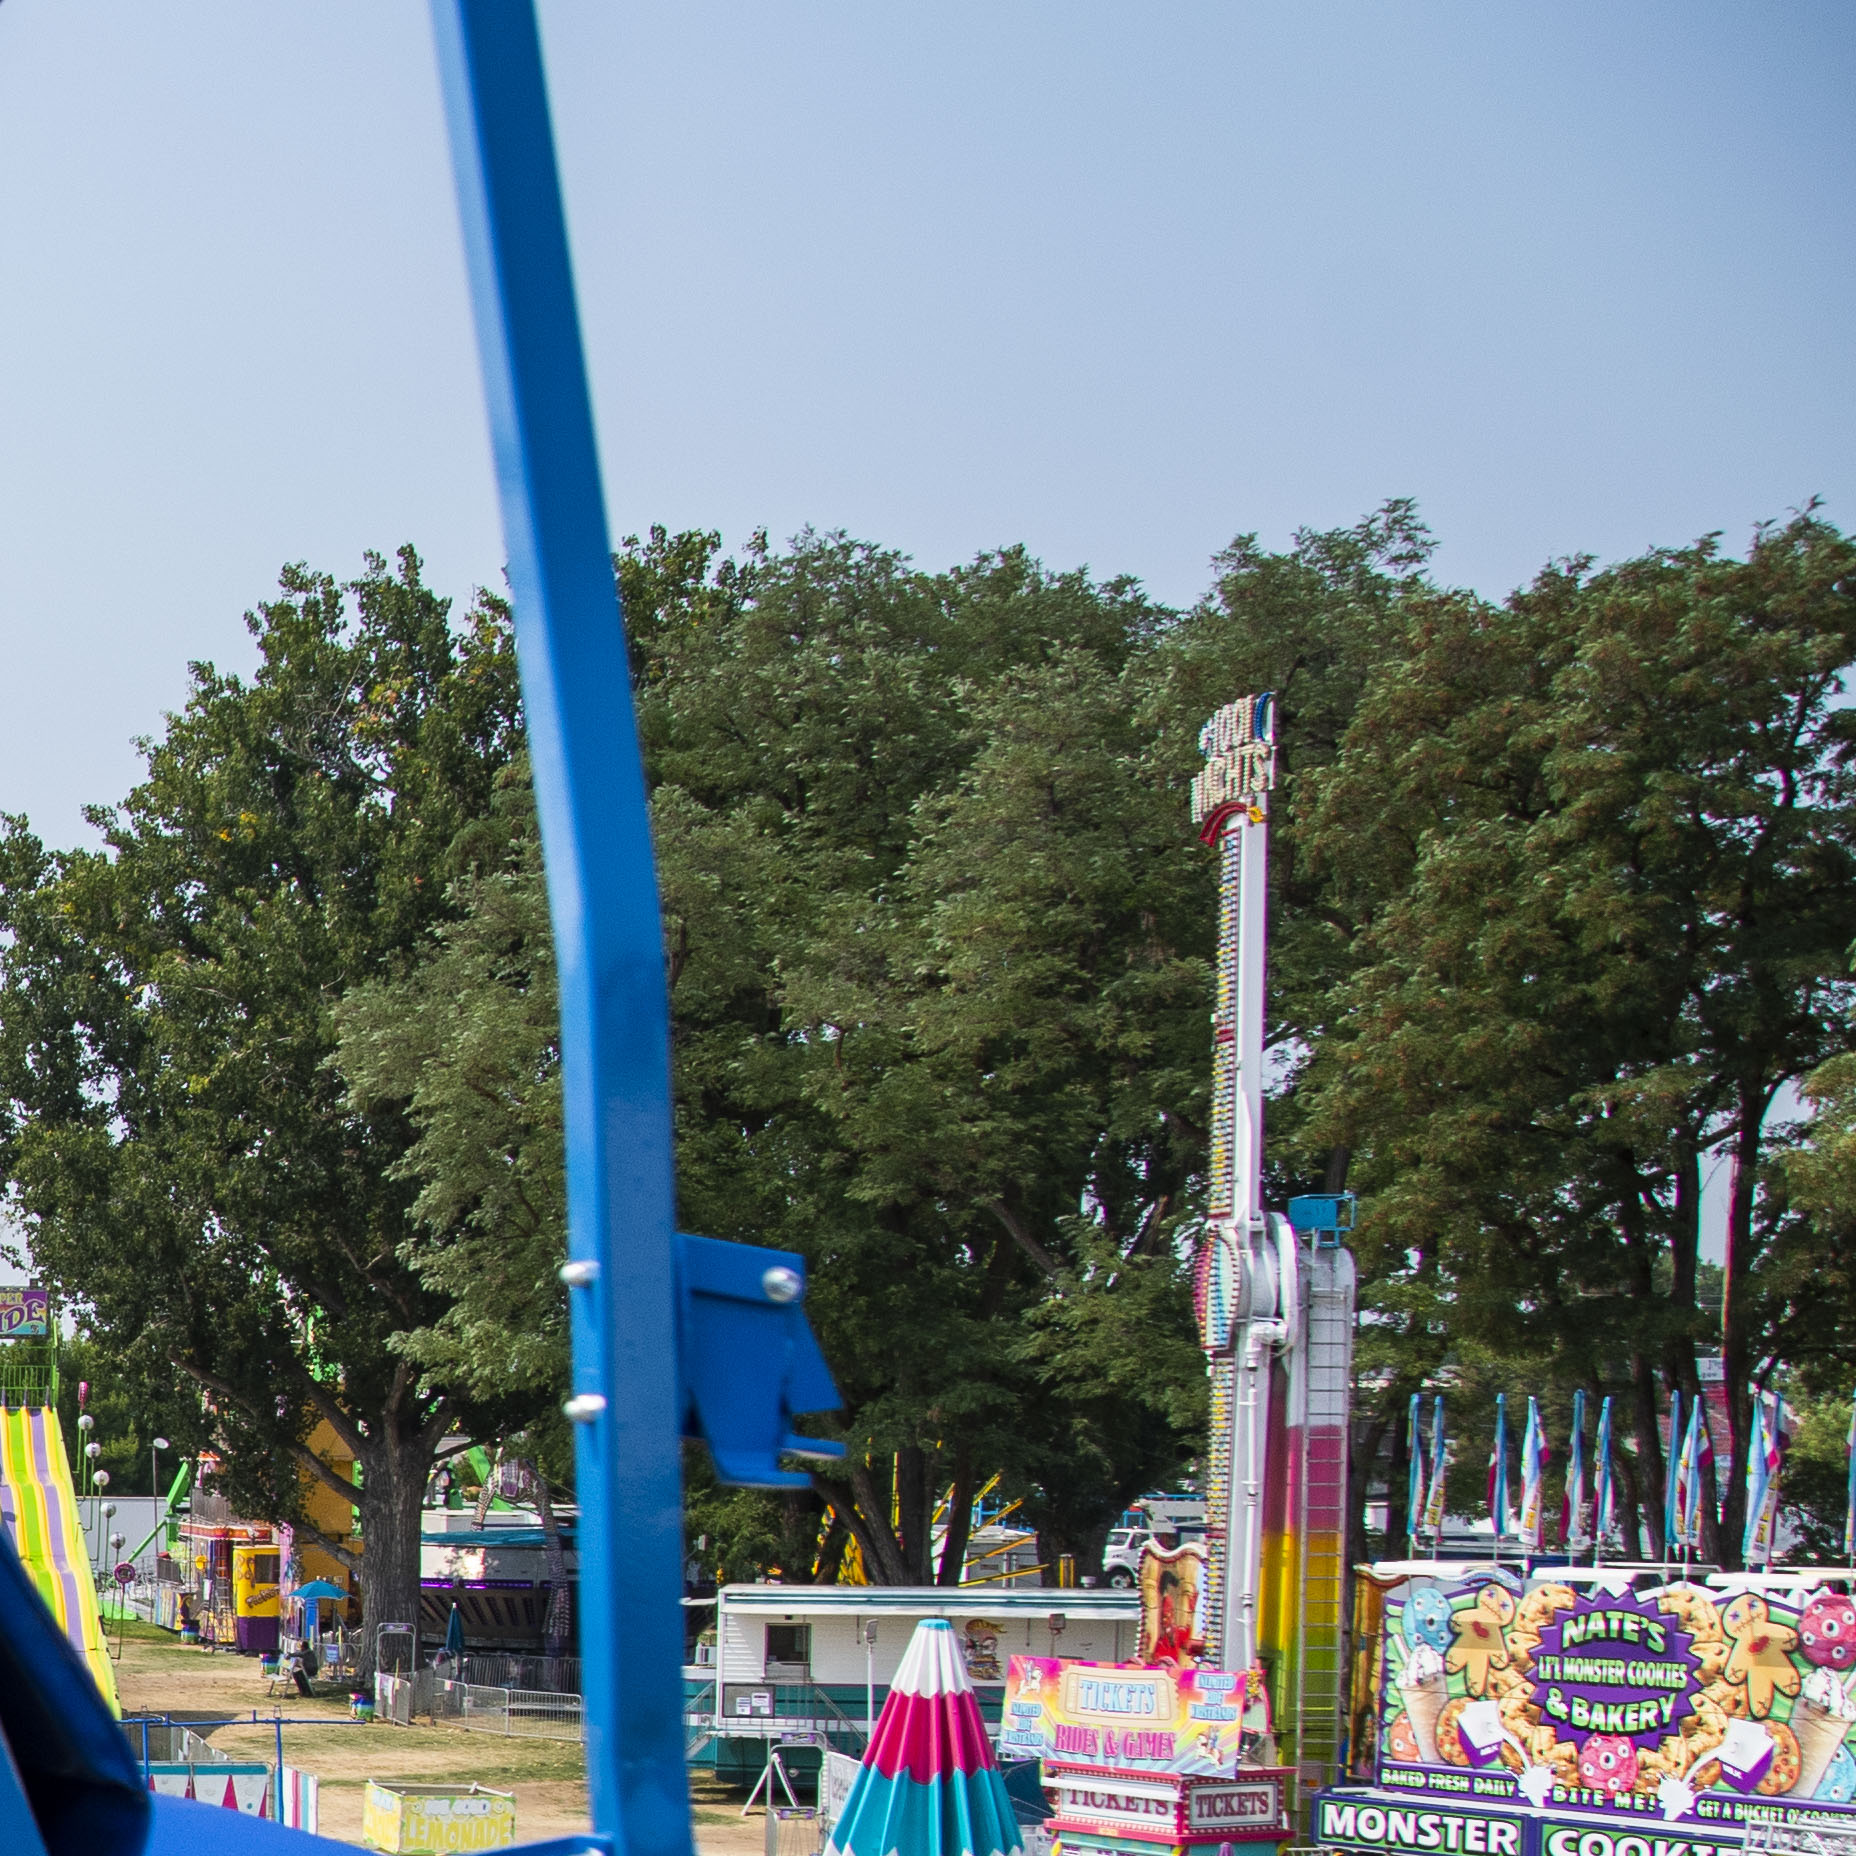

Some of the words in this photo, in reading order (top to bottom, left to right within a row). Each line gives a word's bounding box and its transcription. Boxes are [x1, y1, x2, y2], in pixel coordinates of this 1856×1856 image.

[1191, 743, 1270, 824] NIGHTS
[1561, 1609, 1667, 1653] NATE'S
[1563, 1656, 1626, 1685] MONSTER
[1626, 1660, 1688, 1690] COOKIES
[1079, 1679, 1156, 1714] TICKETS
[1545, 1686, 1570, 1721] &
[1571, 1692, 1678, 1733] BAKERY
[1054, 1723, 1099, 1757] RIDES
[1104, 1730, 1119, 1758] &
[1123, 1731, 1177, 1760] GAMES
[1380, 1768, 1426, 1788] BAKED
[1428, 1772, 1470, 1793] FRESH
[1473, 1777, 1516, 1798] DAILY
[1552, 1784, 1606, 1807] BITE
[1614, 1790, 1656, 1812] ME!
[1068, 1788, 1169, 1817] TICKETS
[1195, 1791, 1270, 1819] TICKETS
[1696, 1799, 1721, 1819] GET
[1722, 1801, 1734, 1818] A
[1734, 1803, 1785, 1823] BUCKET
[1322, 1803, 1519, 1856] MONSTER
